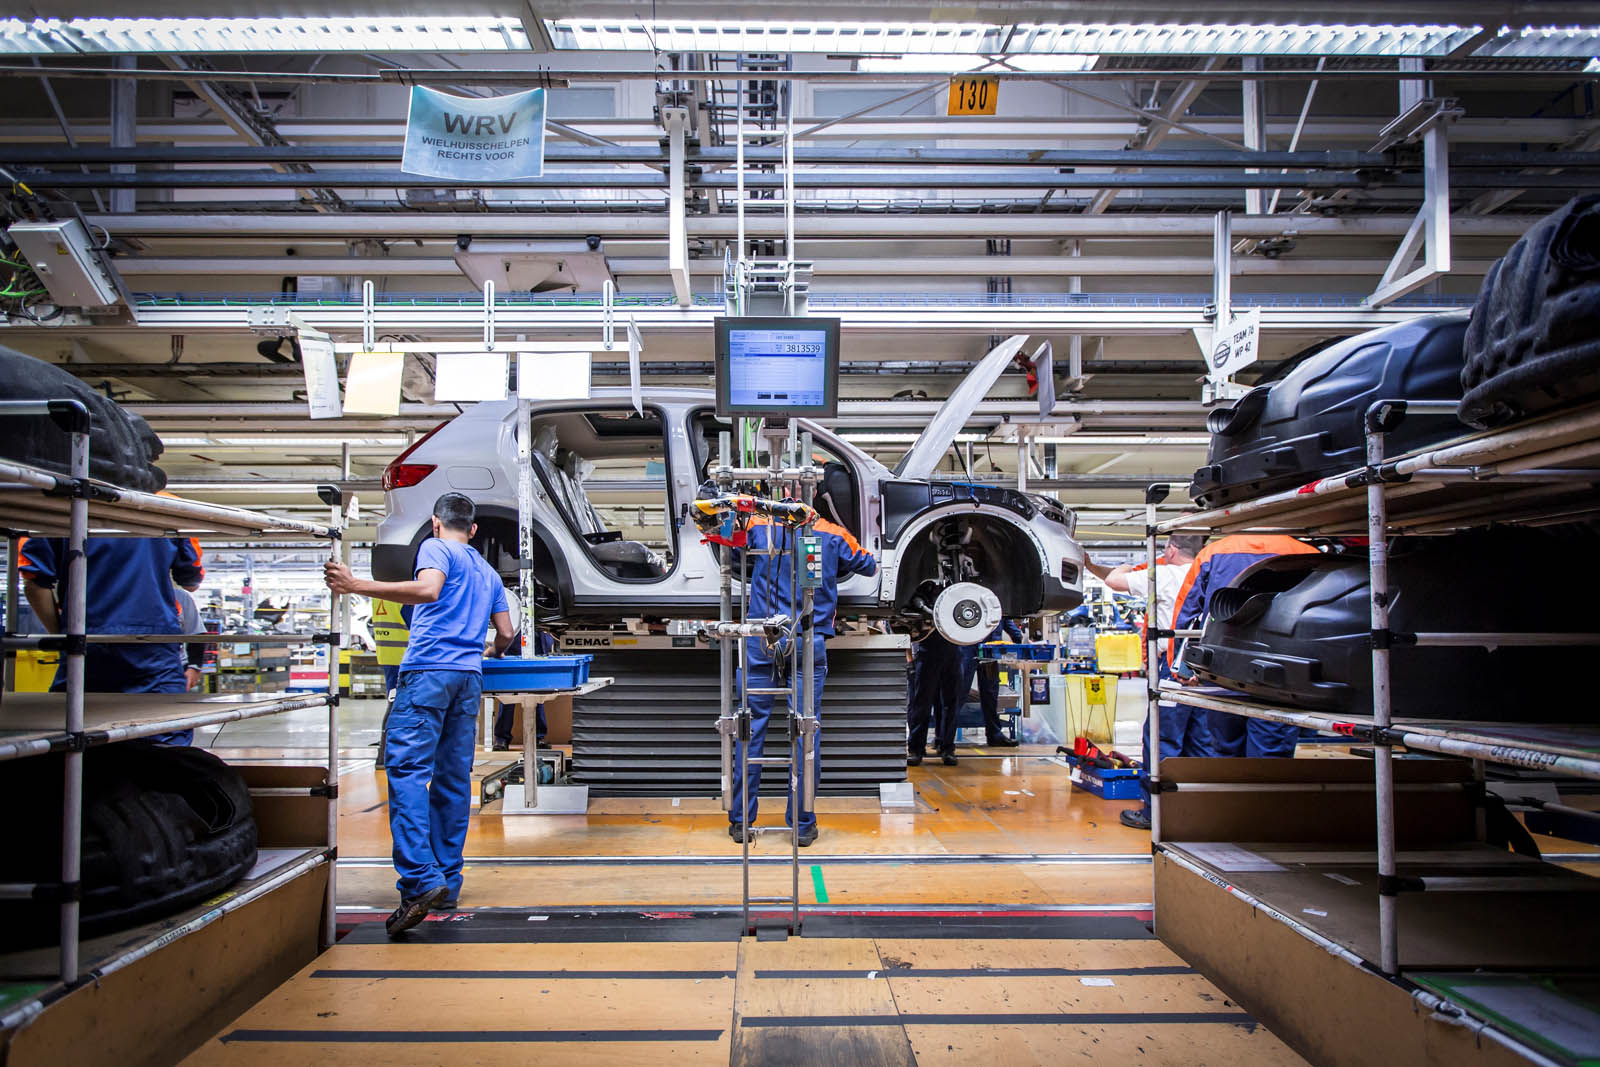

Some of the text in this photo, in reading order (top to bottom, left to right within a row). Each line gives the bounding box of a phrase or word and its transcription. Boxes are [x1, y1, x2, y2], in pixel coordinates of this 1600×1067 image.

[959, 79, 988, 110] 130
[443, 111, 517, 136] WRV
[421, 136, 530, 150] WIELHUISSCHELPEN
[437, 149, 515, 161] RECHTS VOOR
[1233, 329, 1248, 344] TEAM
[786, 344, 821, 353] 3813539
[565, 638, 611, 646] DEMAG
